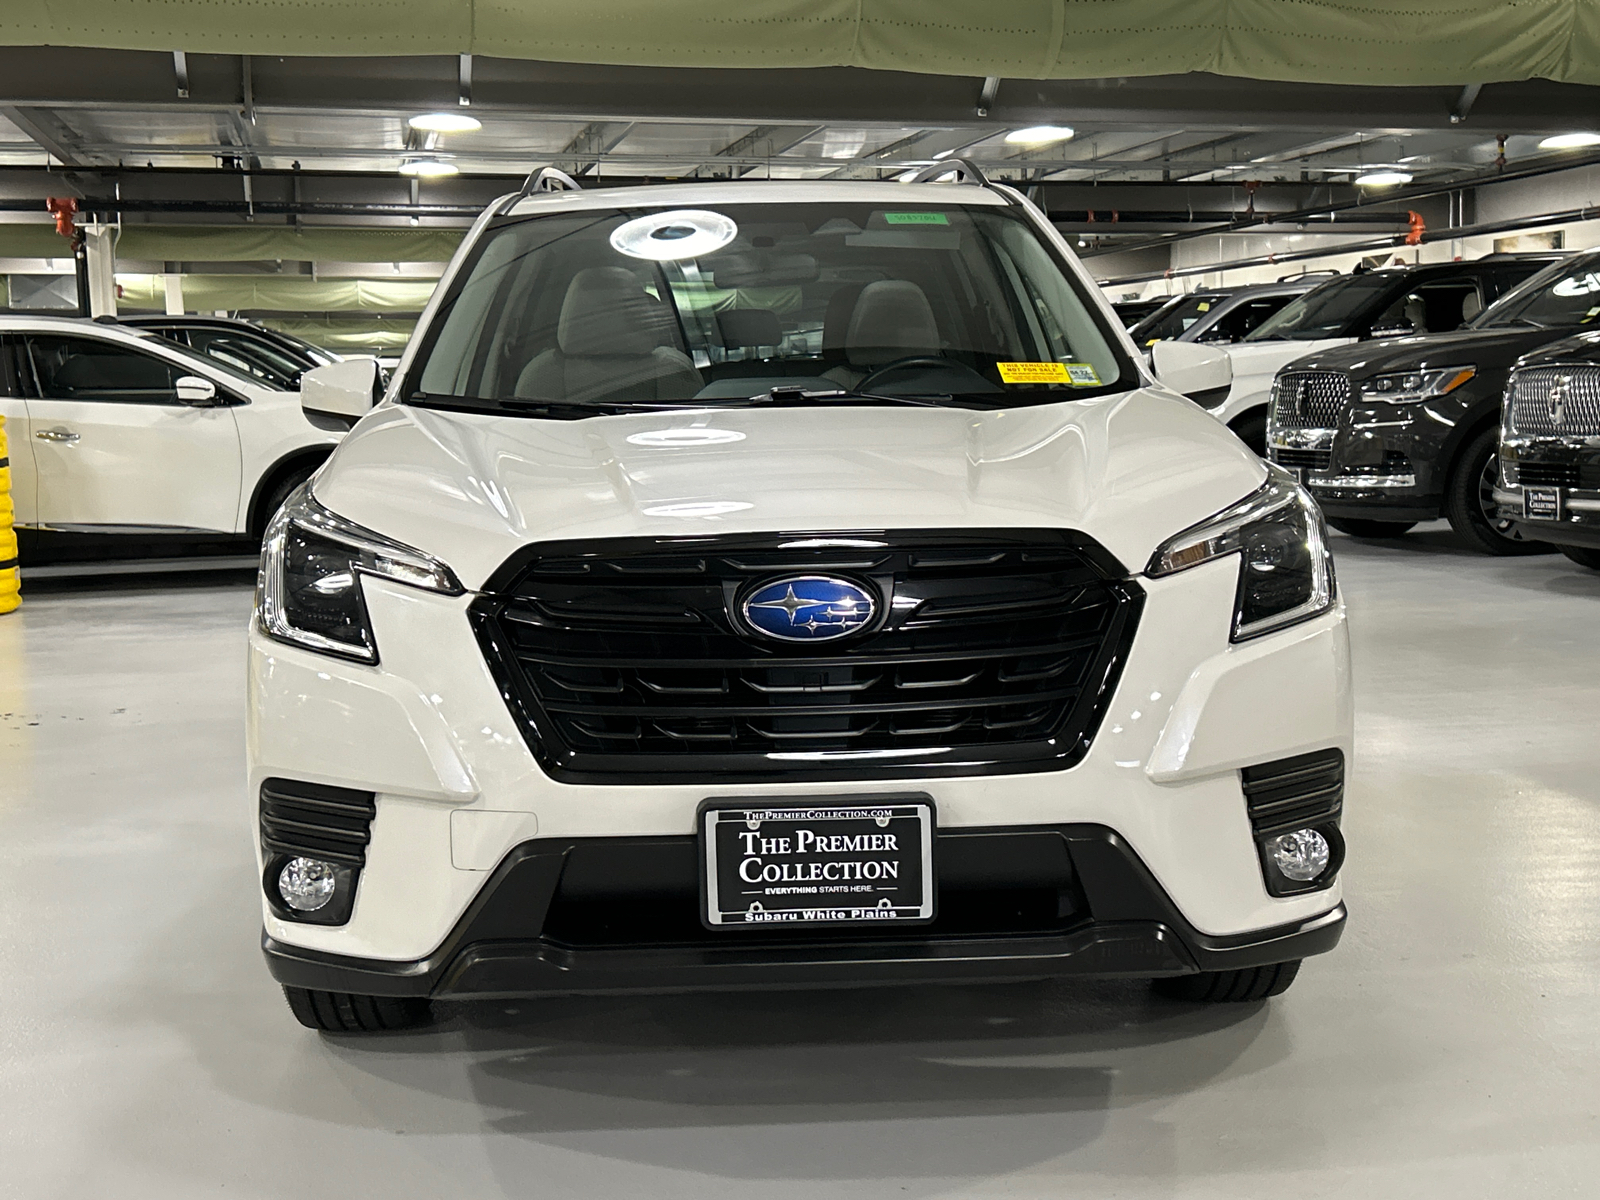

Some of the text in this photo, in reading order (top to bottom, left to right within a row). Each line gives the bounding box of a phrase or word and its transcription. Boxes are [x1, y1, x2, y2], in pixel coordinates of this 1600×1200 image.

[765, 886, 818, 895] EVERYTHING
[819, 885, 849, 894] STARTS
[745, 909, 897, 922] Subaru White Plains
